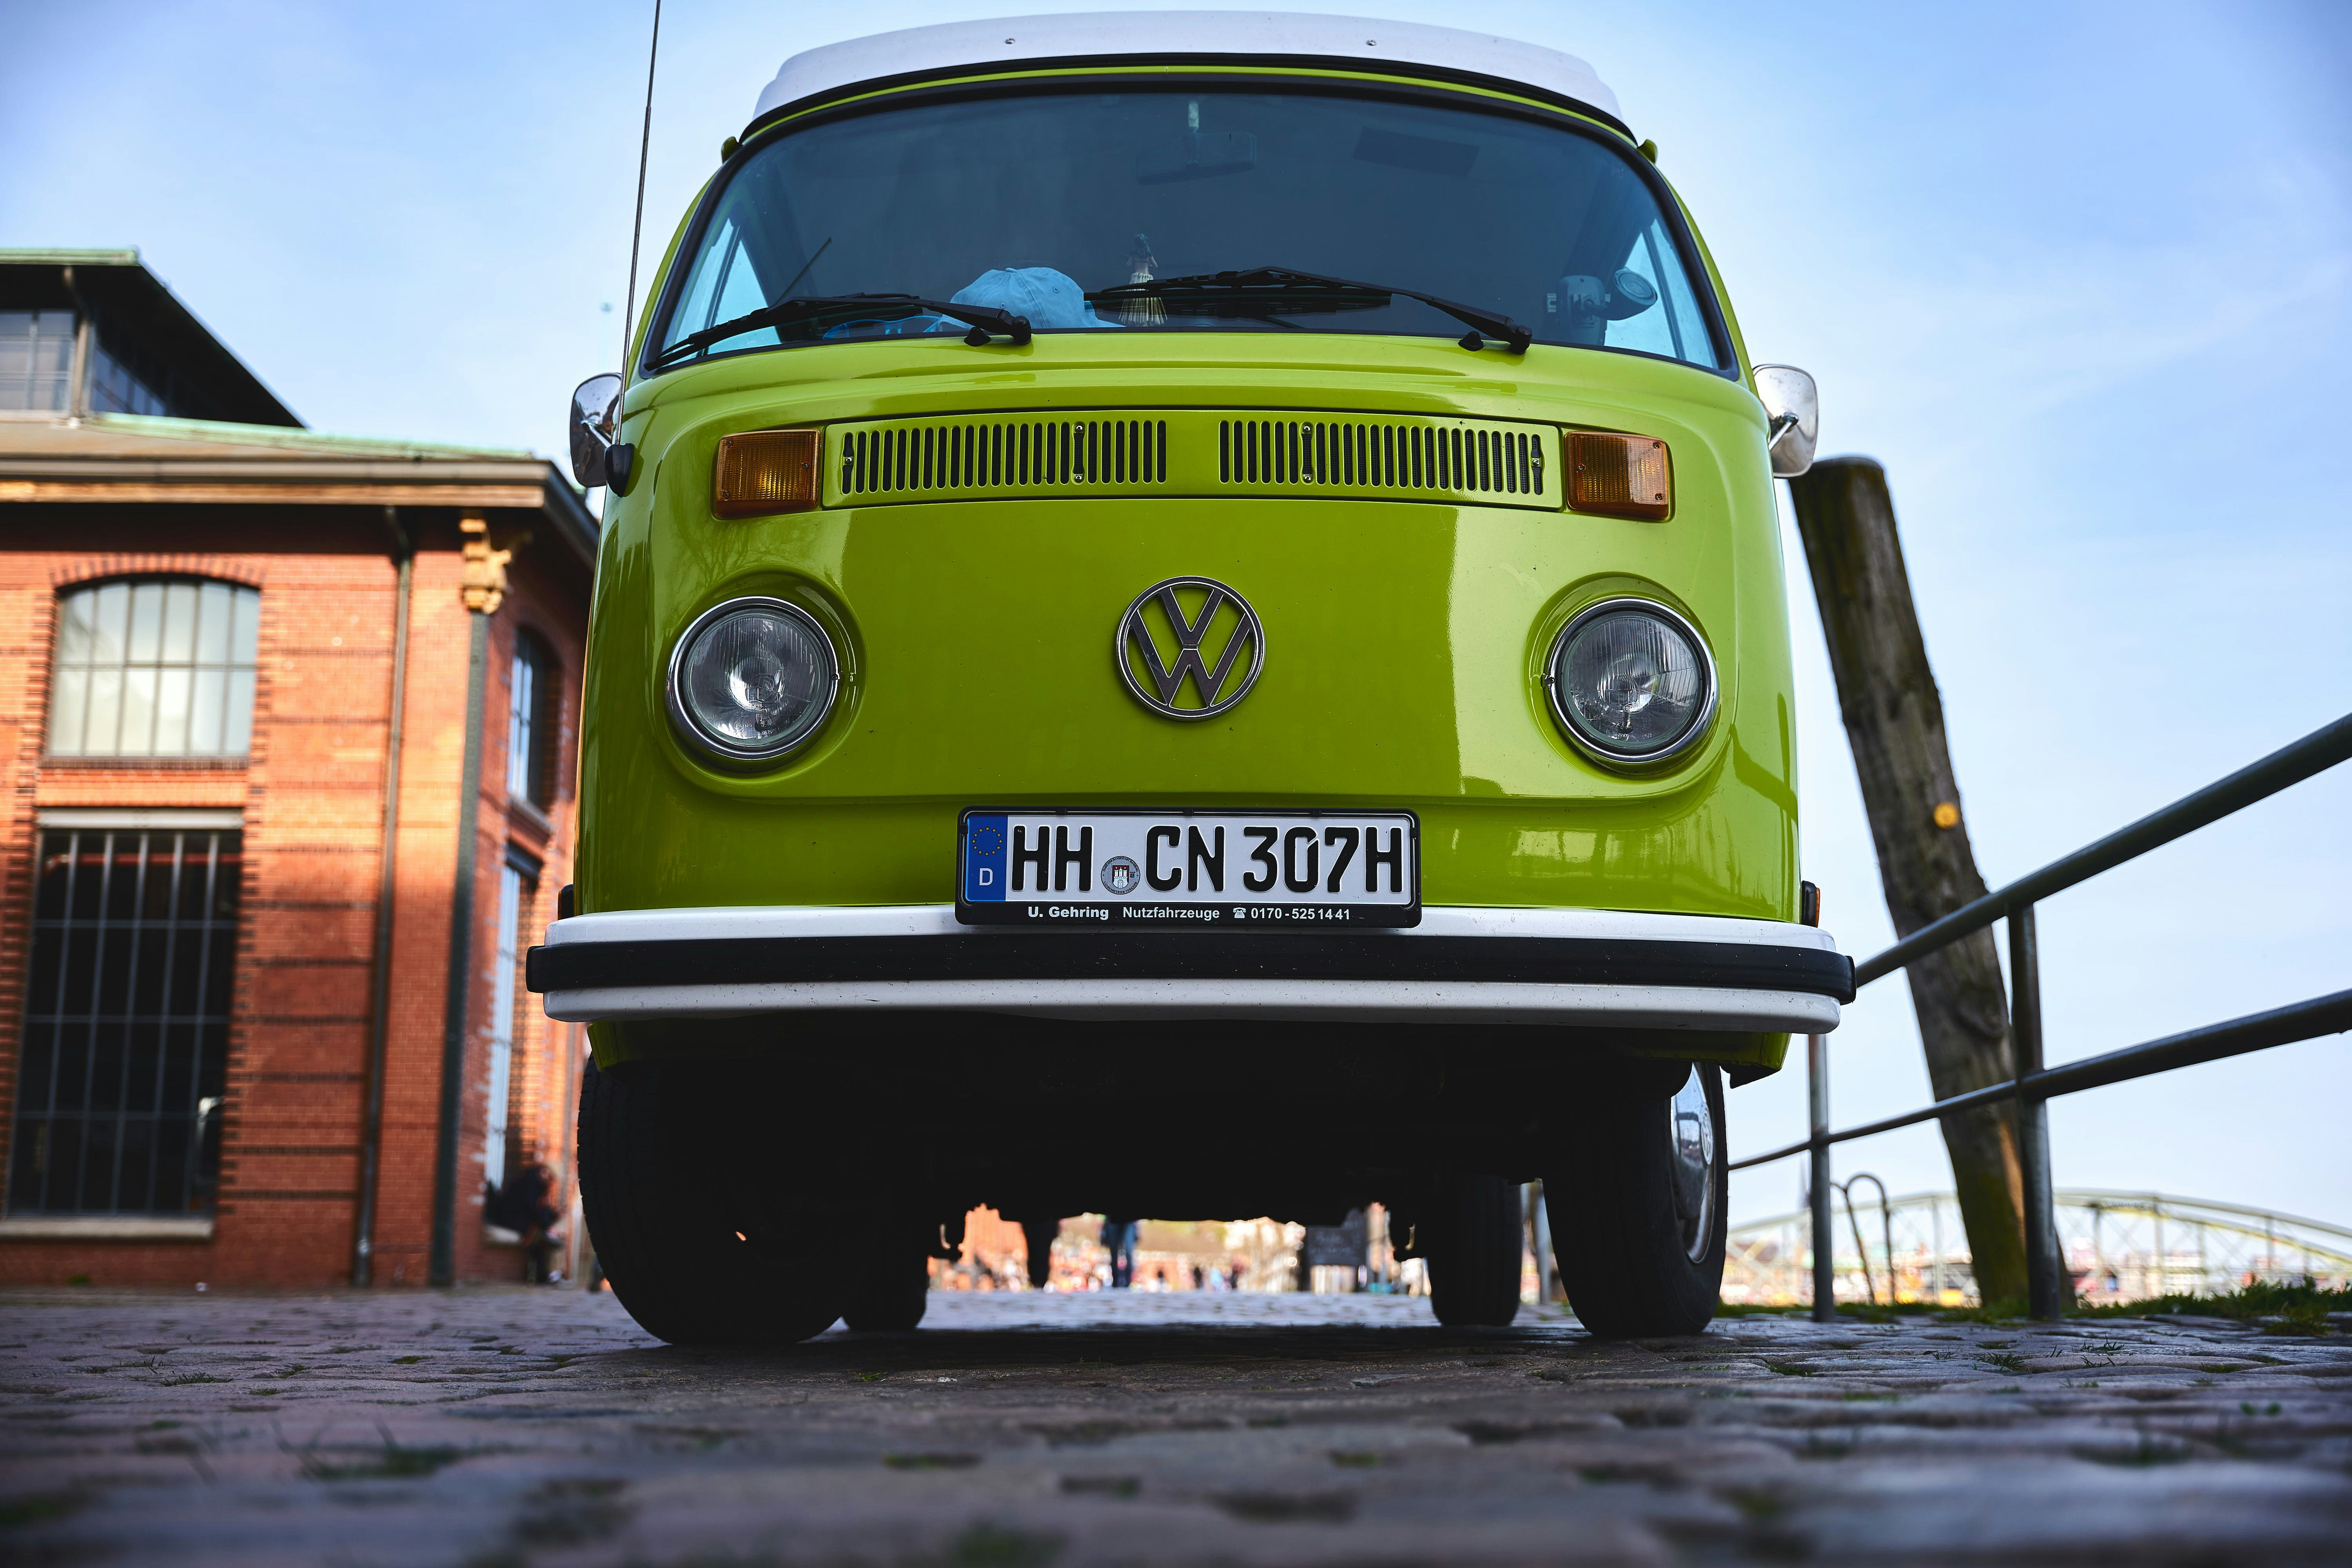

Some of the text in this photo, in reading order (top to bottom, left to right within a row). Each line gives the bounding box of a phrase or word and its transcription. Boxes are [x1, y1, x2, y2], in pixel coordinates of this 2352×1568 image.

[1011, 825, 1403, 893] HH CN 307H
[979, 868, 993, 886] D
[1028, 906, 1043, 917] U.
[1049, 906, 1109, 920] Gehring
[1123, 907, 1220, 921] Nutzfahrzeuge
